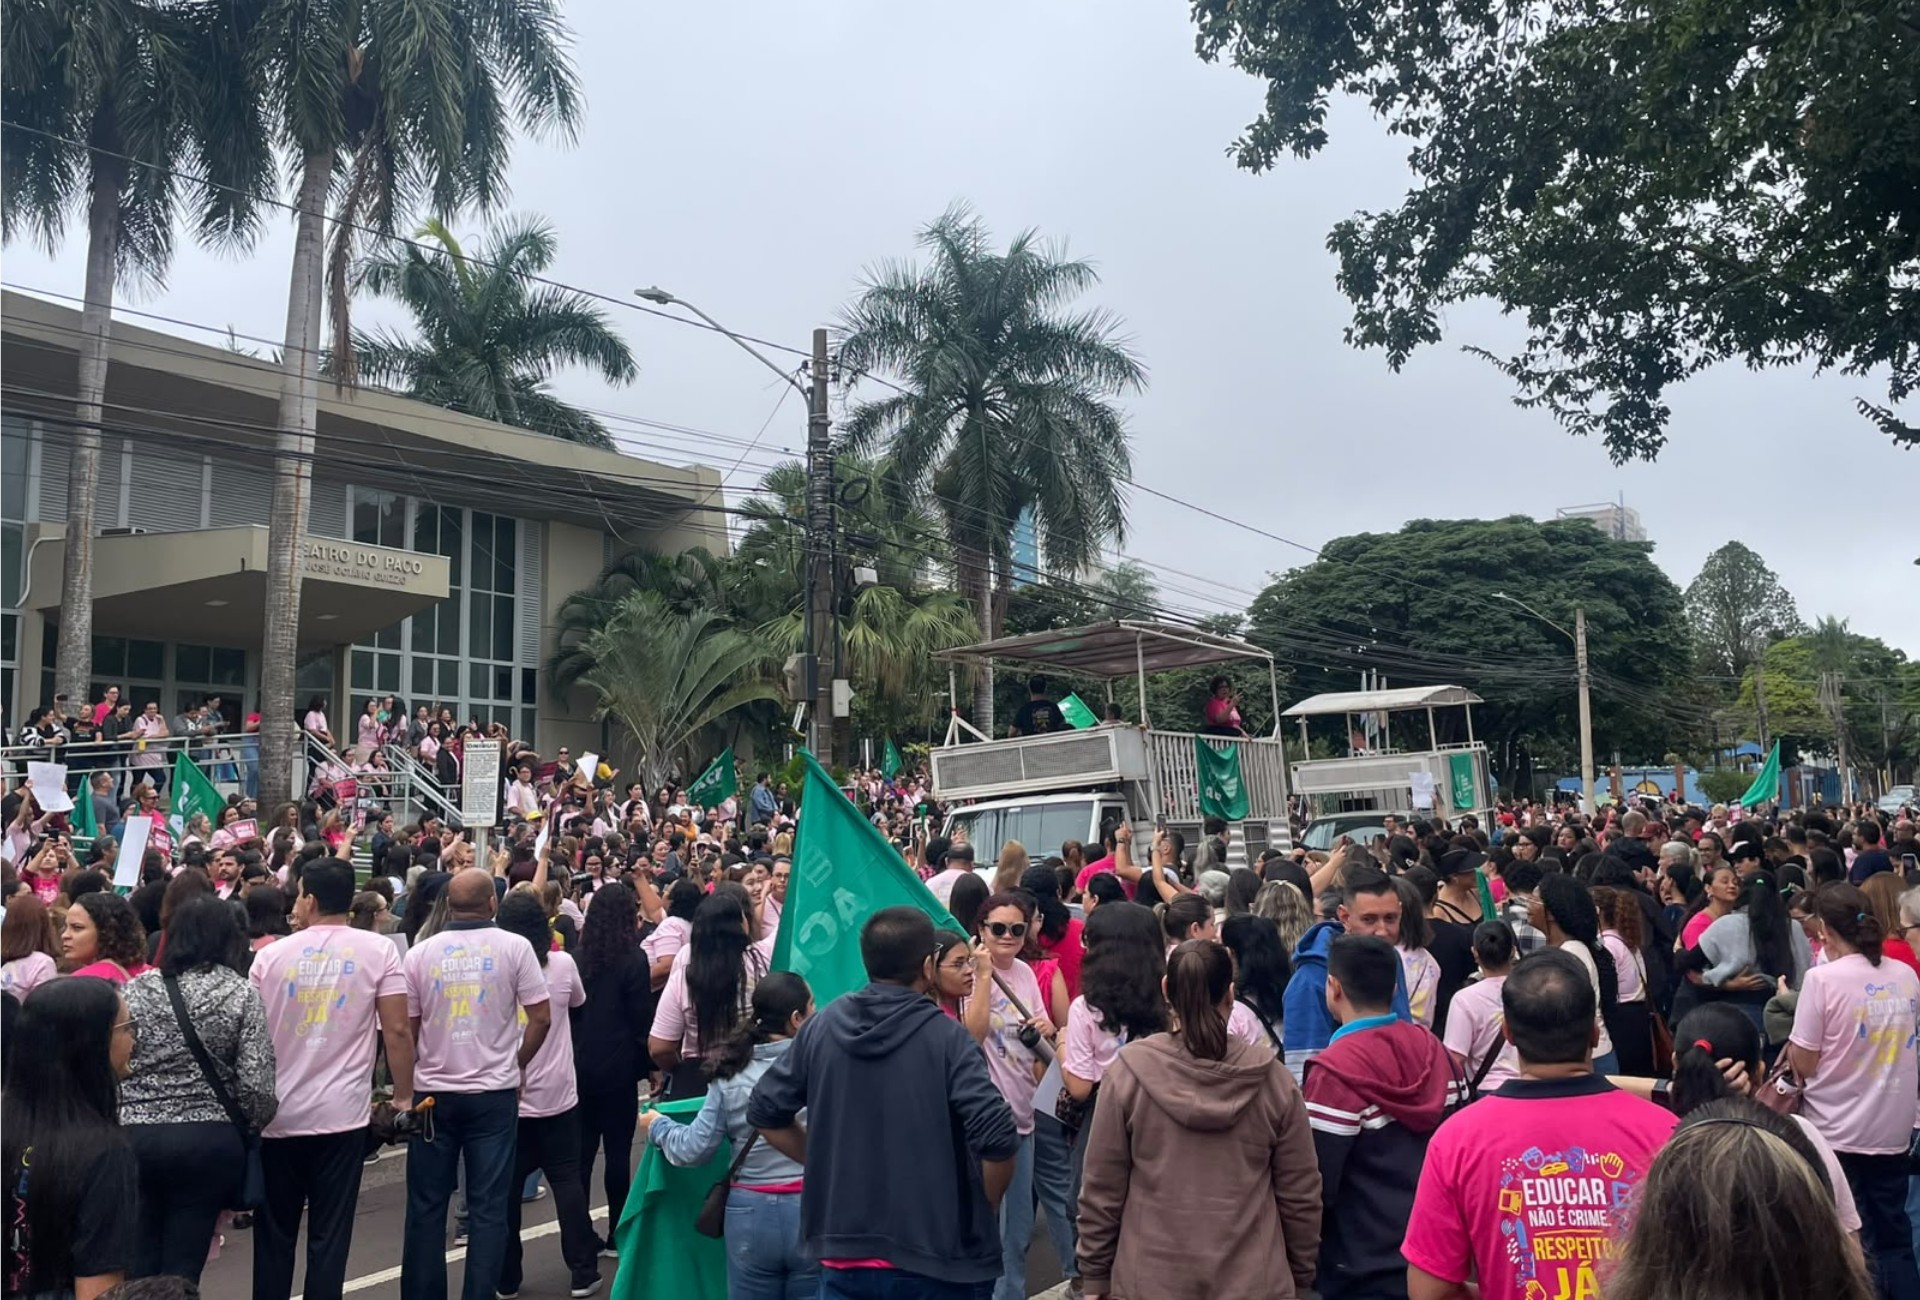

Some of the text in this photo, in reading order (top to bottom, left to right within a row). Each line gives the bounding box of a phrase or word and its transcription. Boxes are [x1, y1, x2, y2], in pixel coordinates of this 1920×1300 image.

[304, 543, 350, 564] EATRO
[357, 551, 379, 568] DO
[1521, 1177, 1607, 1206] EDUCAR
[1528, 1207, 1555, 1227] NÃO
[1557, 1206, 1567, 1226] É
